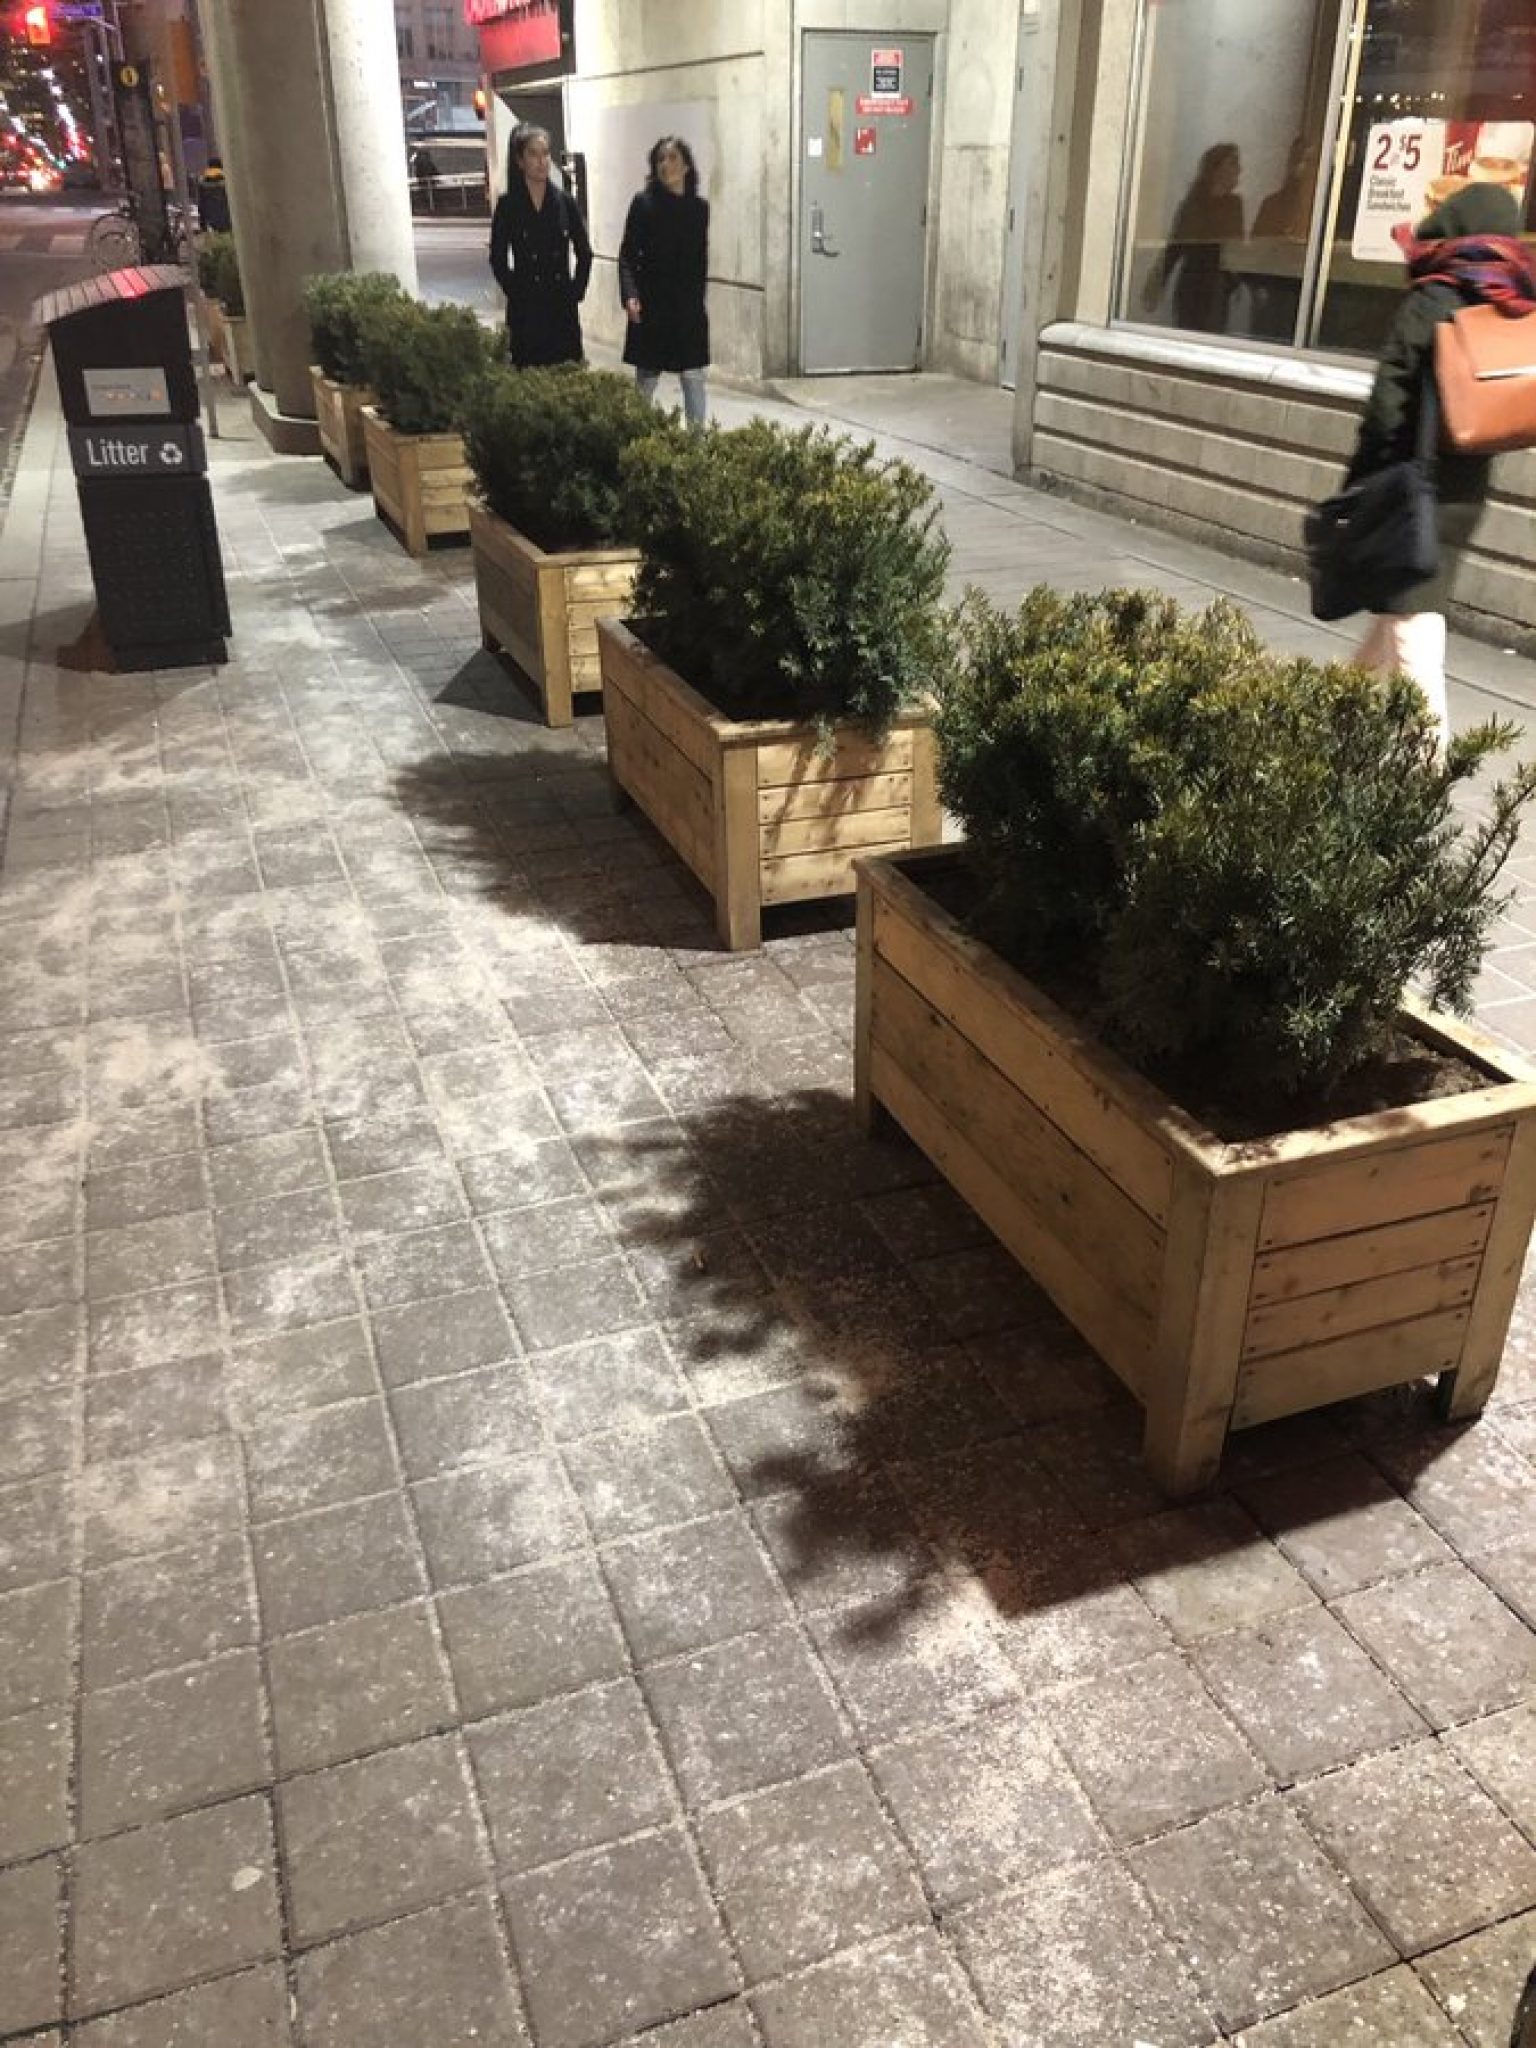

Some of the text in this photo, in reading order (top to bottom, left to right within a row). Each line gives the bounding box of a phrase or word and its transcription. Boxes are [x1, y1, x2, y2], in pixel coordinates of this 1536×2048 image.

[1373, 133, 1423, 171] 2 $5
[86, 438, 149, 466] Litter
